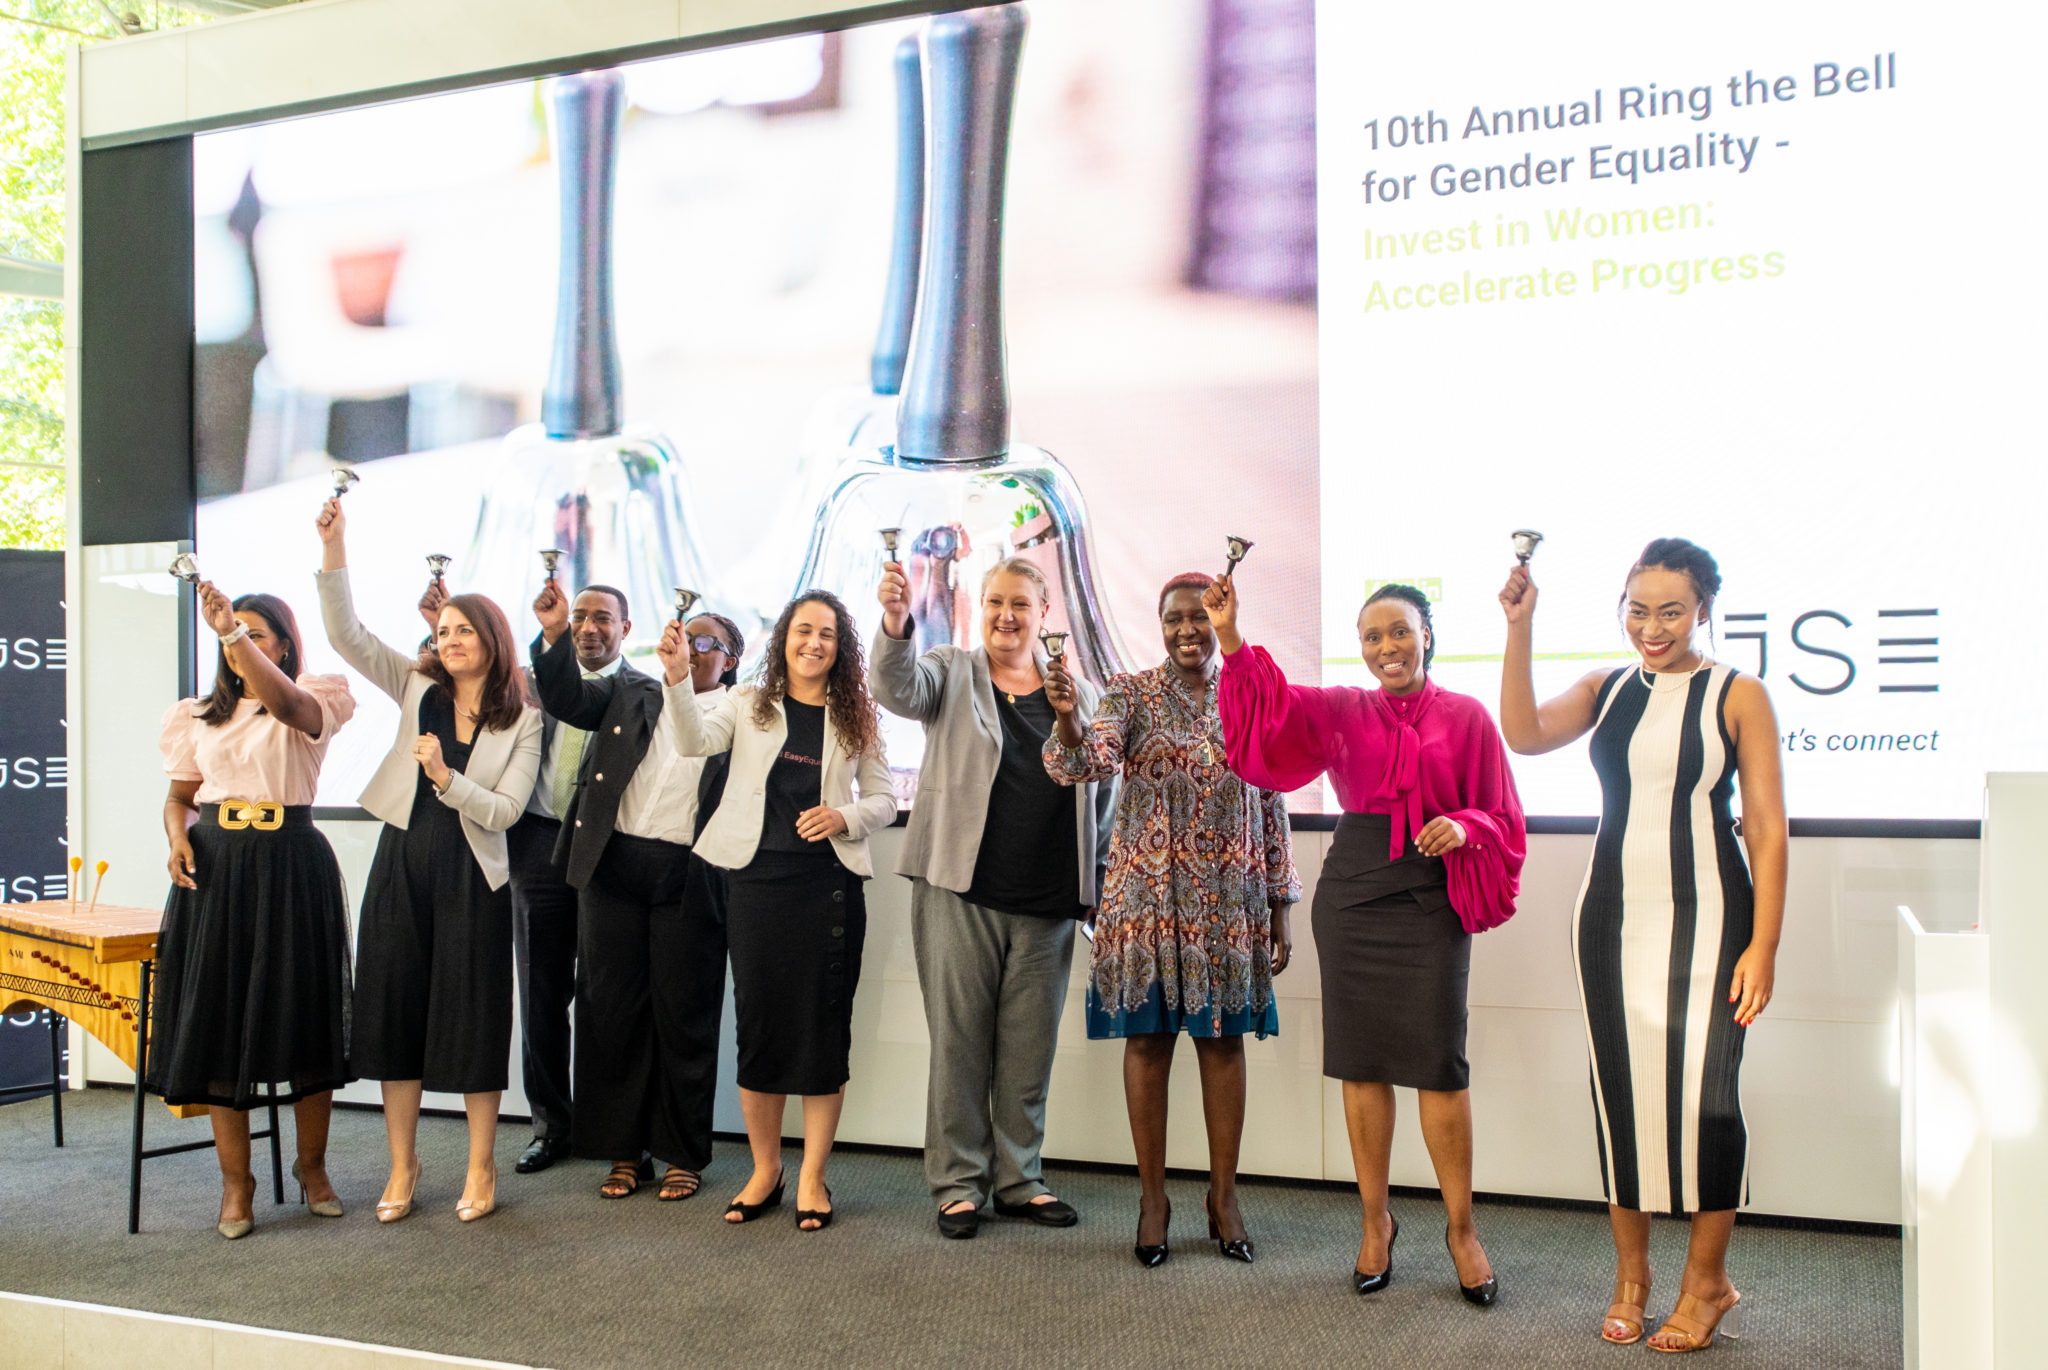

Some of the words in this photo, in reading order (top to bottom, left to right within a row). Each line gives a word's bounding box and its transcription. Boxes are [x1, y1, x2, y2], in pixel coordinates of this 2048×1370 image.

[1363, 109, 1449, 151] 10th
[1461, 88, 1602, 140] Annual
[1619, 82, 1712, 122] Ring
[1726, 69, 1797, 108] the
[1813, 51, 1896, 98] Bell
[1361, 169, 1417, 205] for
[1430, 151, 1576, 197] Gender
[1589, 131, 1760, 185] Equality
[1364, 219, 1483, 261] Invest
[1495, 214, 1530, 248] in
[1544, 201, 1715, 243] Women:
[1363, 266, 1578, 313] Accelerate
[1591, 251, 1785, 296] Progress
[1782, 727, 1817, 752] t's
[1826, 729, 1940, 752] connect
